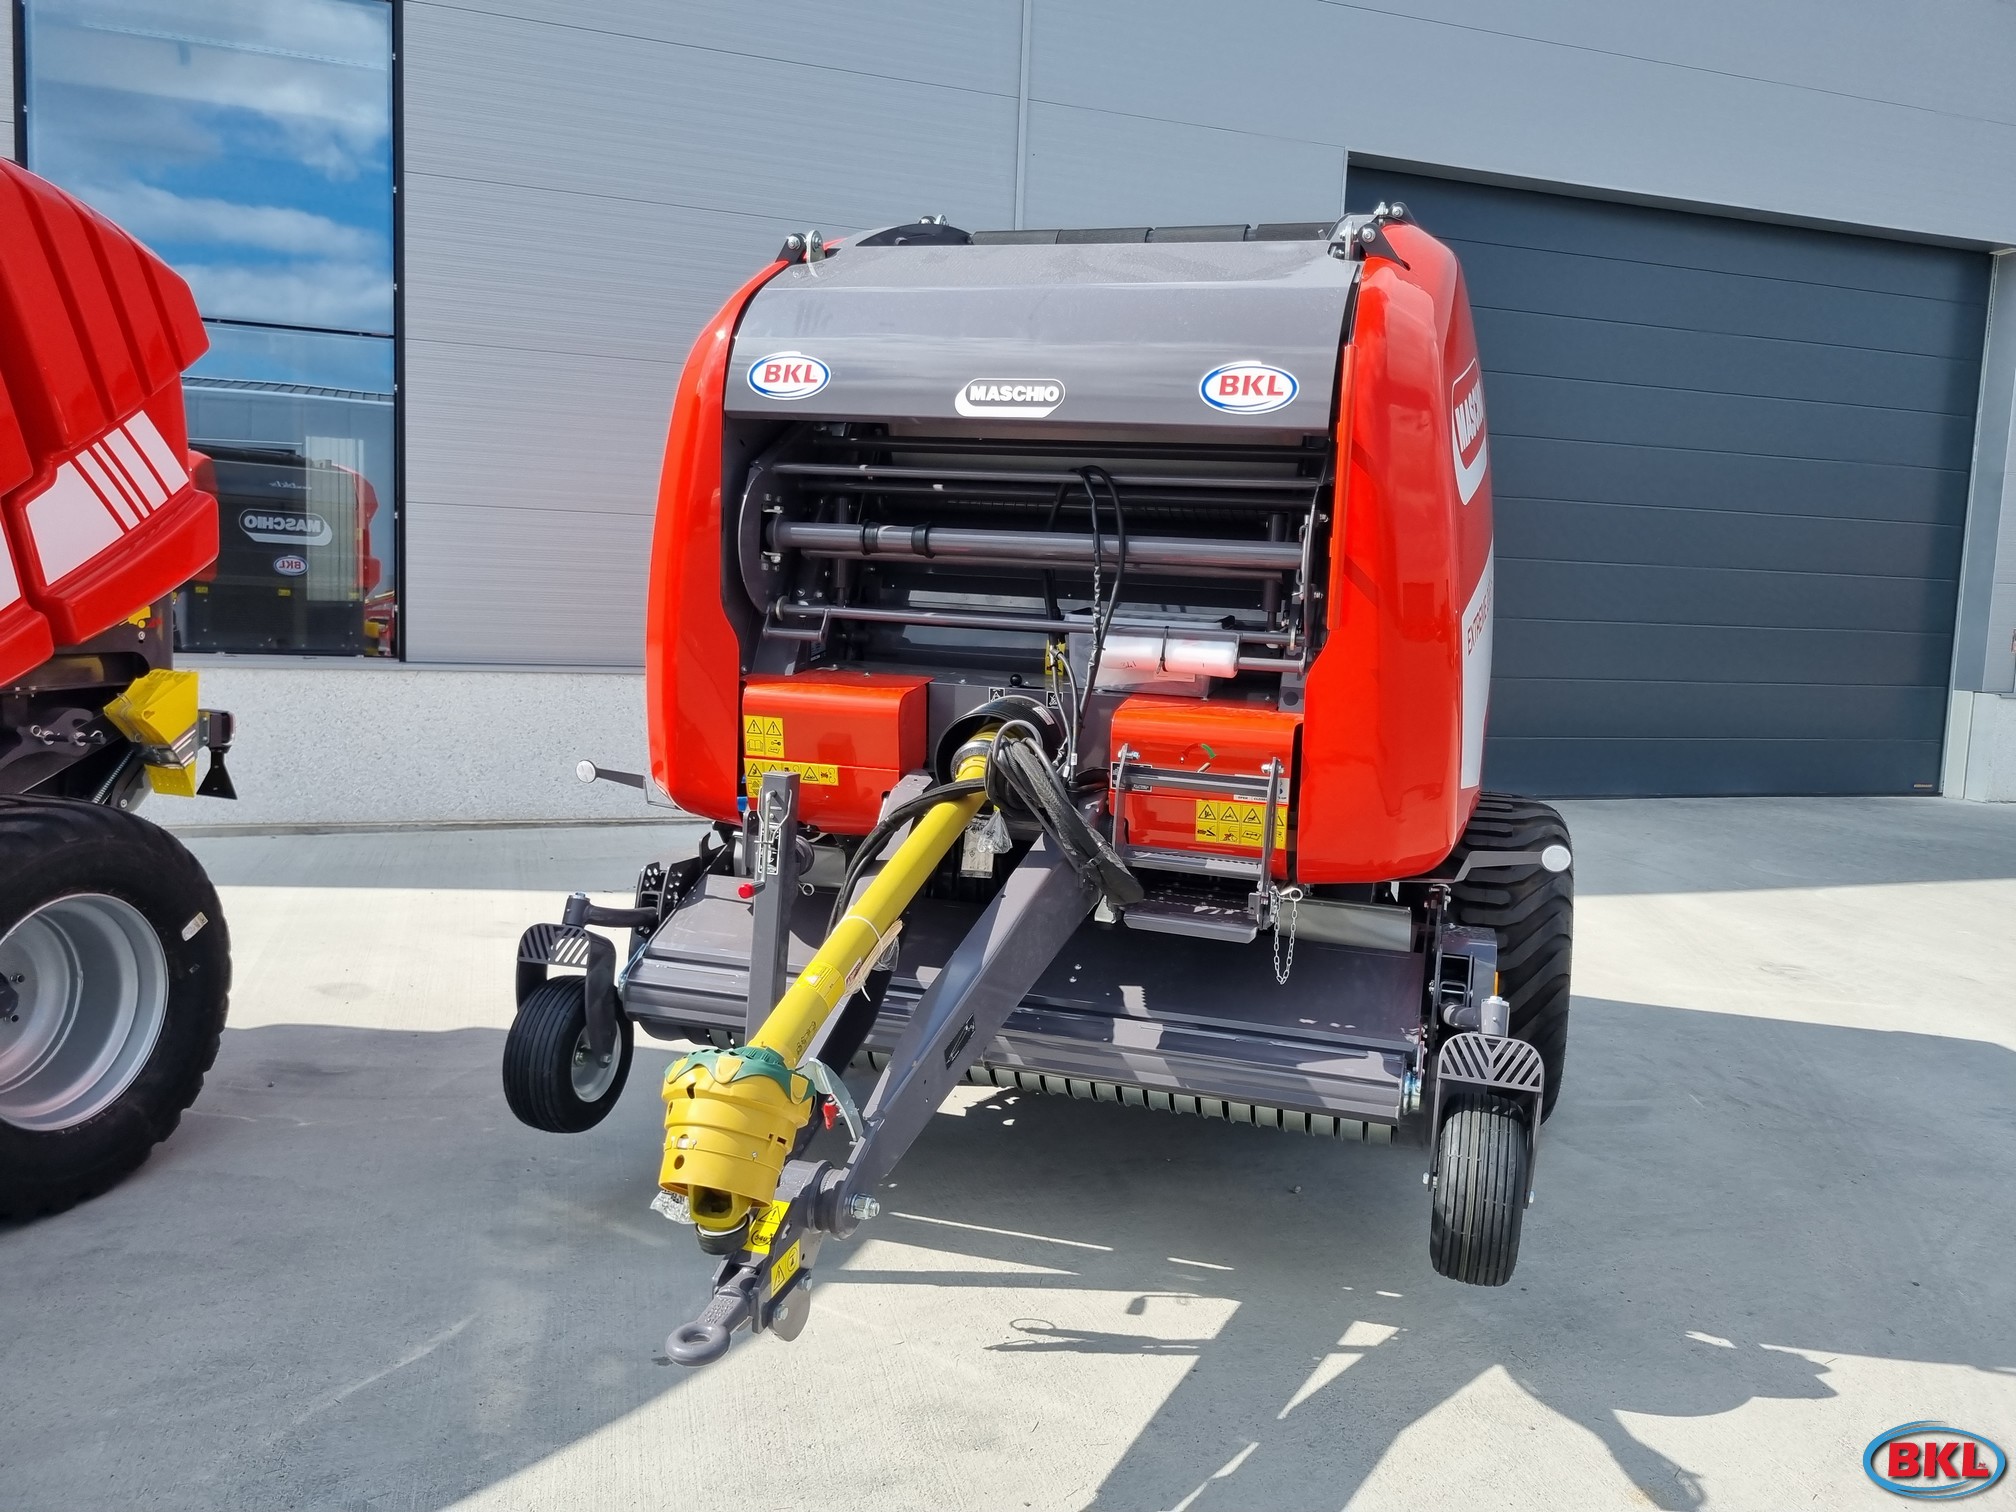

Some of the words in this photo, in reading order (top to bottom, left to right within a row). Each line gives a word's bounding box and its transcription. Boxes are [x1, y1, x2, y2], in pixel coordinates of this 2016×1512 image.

[763, 364, 818, 384] BKL
[969, 384, 1060, 402] MASCHIO
[1218, 375, 1284, 397] BKL
